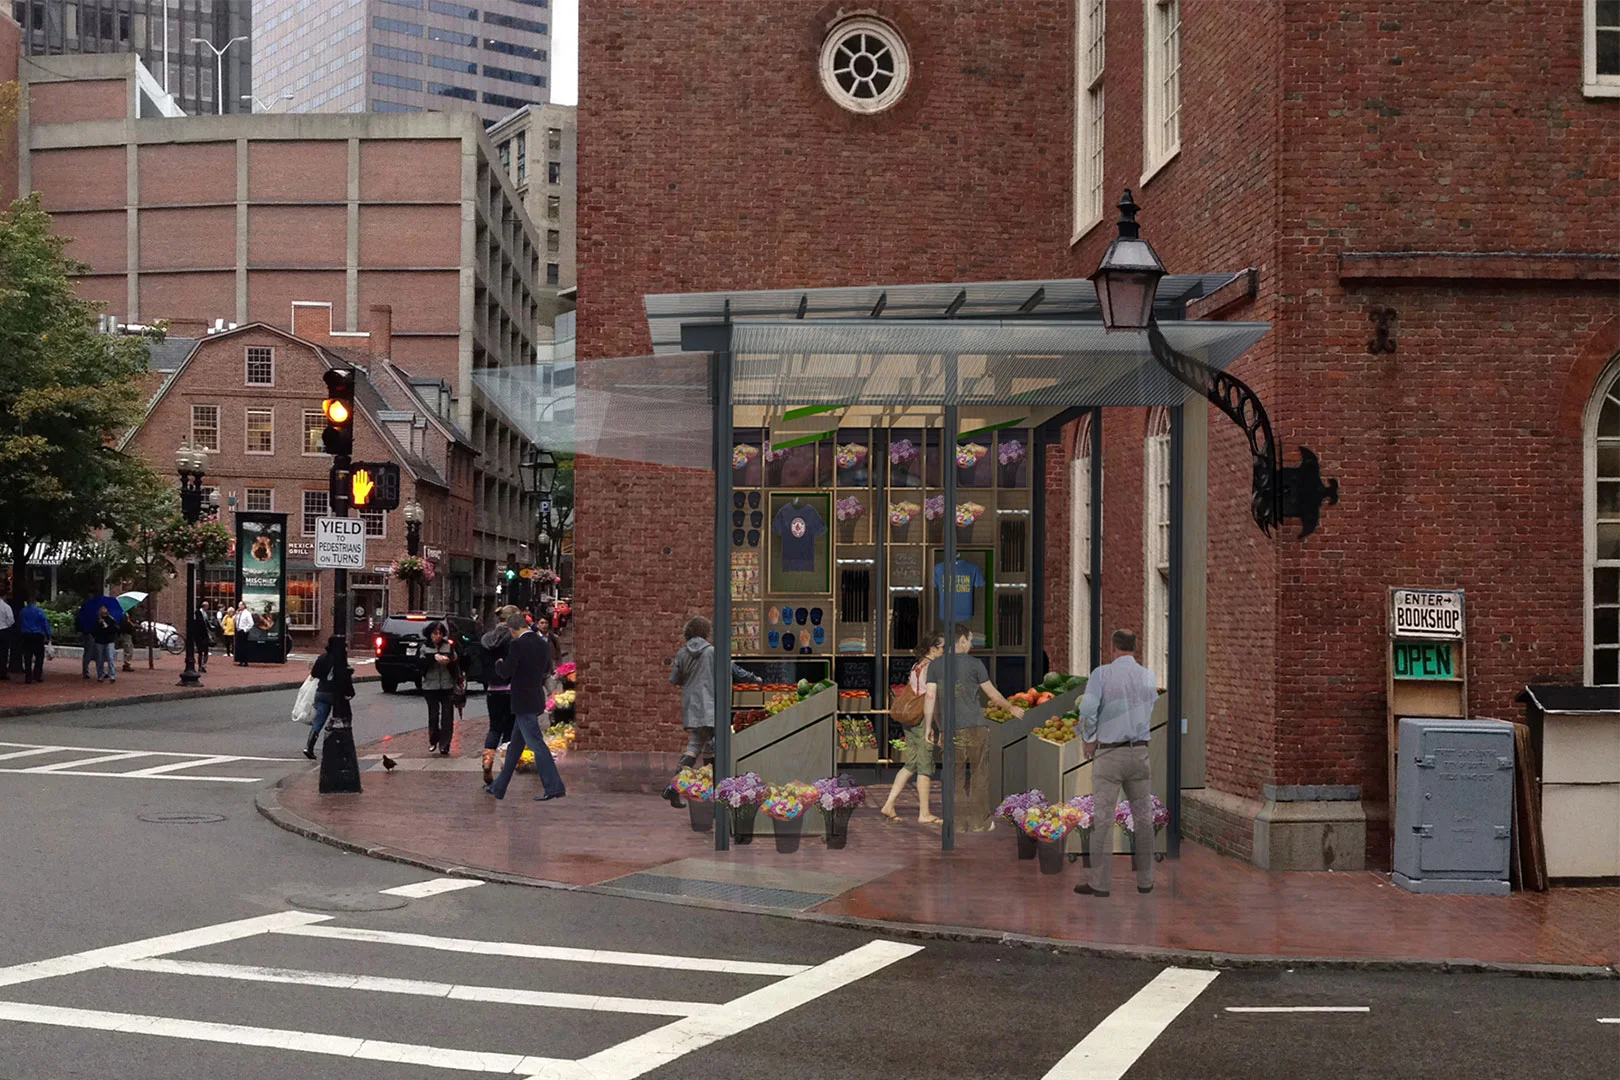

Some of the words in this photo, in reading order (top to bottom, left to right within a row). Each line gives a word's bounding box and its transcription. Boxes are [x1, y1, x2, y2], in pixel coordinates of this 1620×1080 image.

[321, 521, 361, 534] YIELD
[319, 542, 361, 553] PEDESTRIANS
[332, 554, 359, 564] TURNS
[1405, 593, 1444, 606] ENTER
[1397, 607, 1459, 629] BOOKSHOP
[1394, 644, 1451, 676] OPEN
